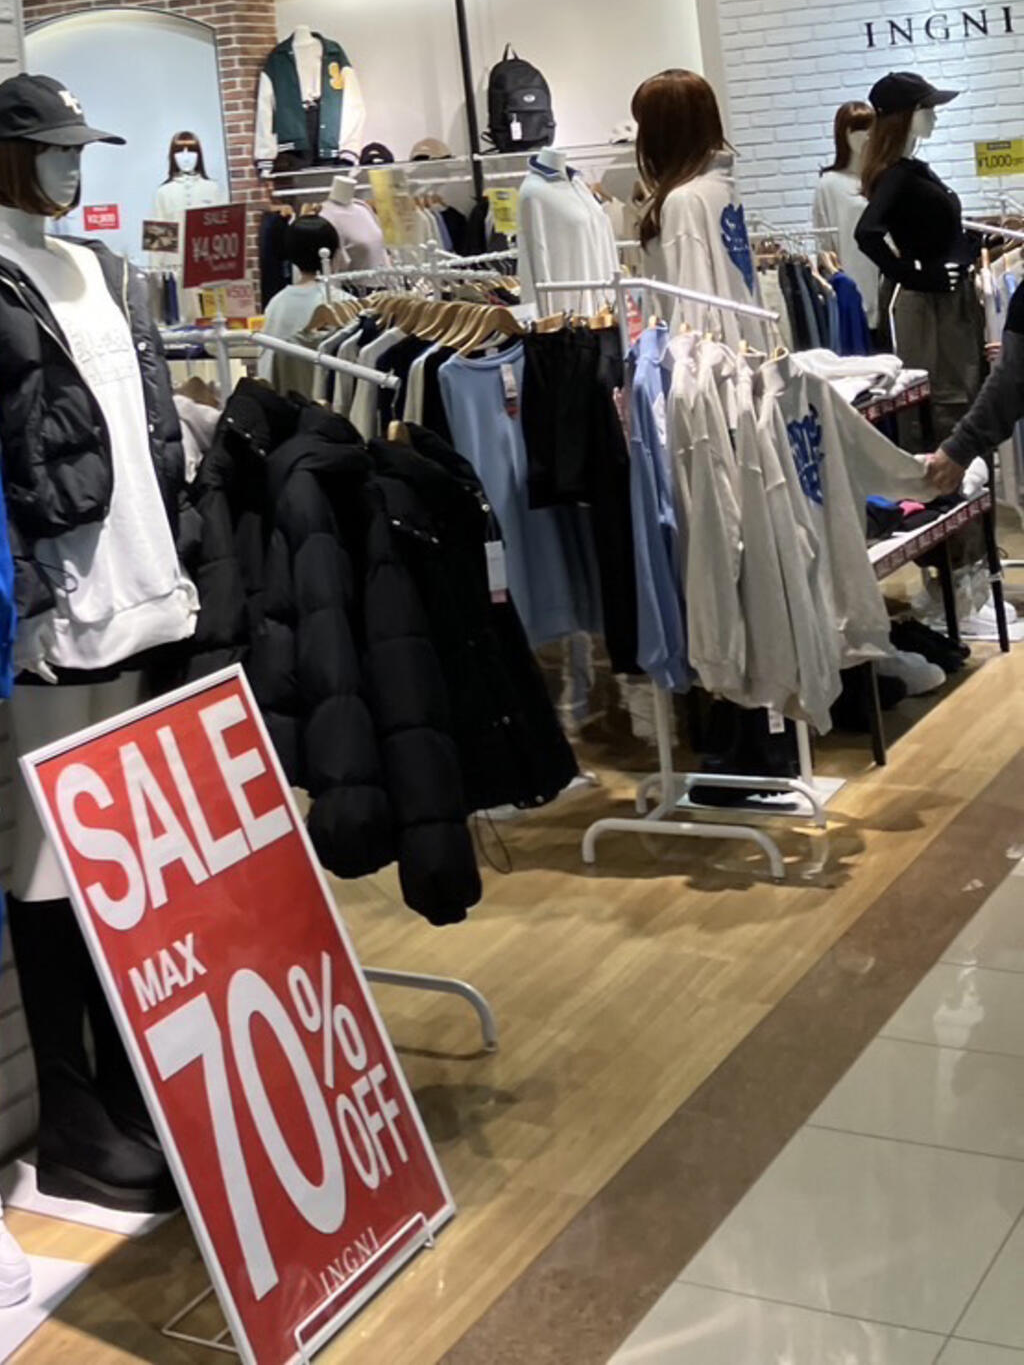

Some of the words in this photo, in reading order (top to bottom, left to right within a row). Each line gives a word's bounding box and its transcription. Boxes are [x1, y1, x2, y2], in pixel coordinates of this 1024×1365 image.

[864, 5, 1015, 48] INGNI
[203, 210, 229, 226] SALE
[54, 694, 294, 931] SALE
[127, 932, 207, 1013] MAX
[144, 951, 368, 1301] 70%
[334, 1063, 408, 1190] OFF
[318, 1225, 381, 1298] INGNI
